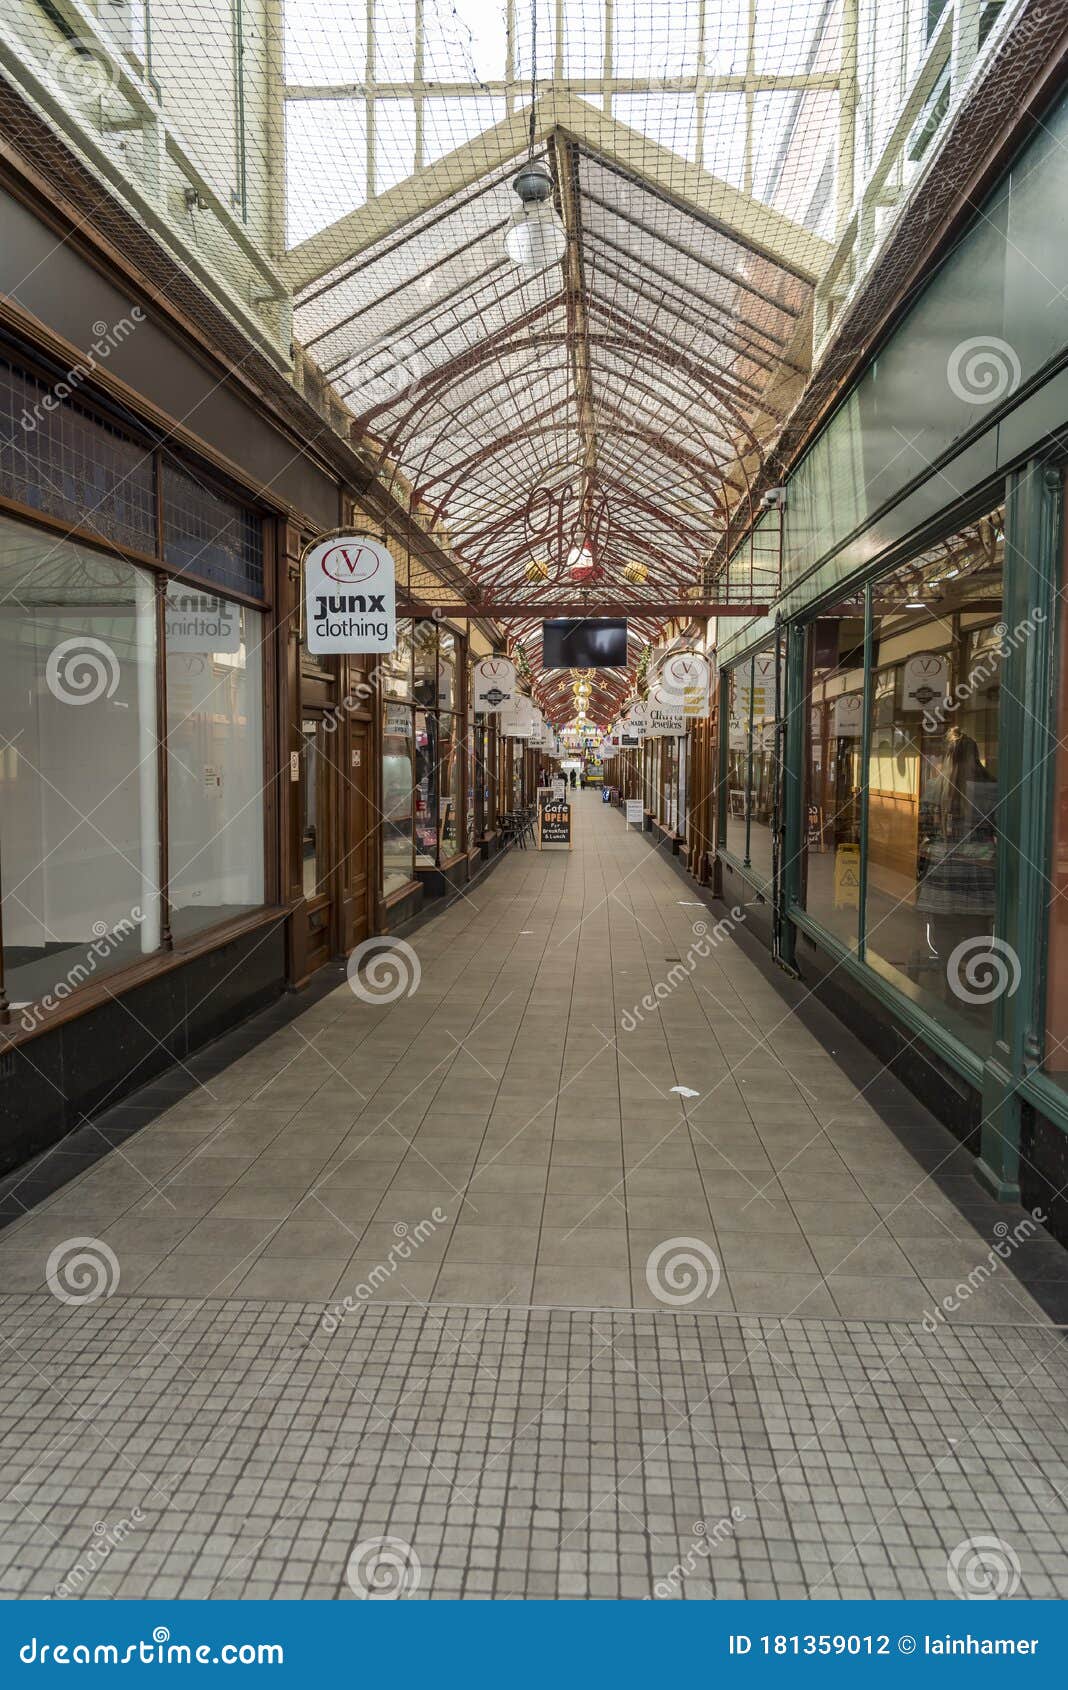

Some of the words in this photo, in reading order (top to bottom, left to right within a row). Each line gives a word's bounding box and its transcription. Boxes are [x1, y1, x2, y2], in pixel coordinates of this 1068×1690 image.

[316, 618, 388, 641] clothing
[545, 804, 569, 812] Cafe
[544, 813, 569, 822] OPEN
